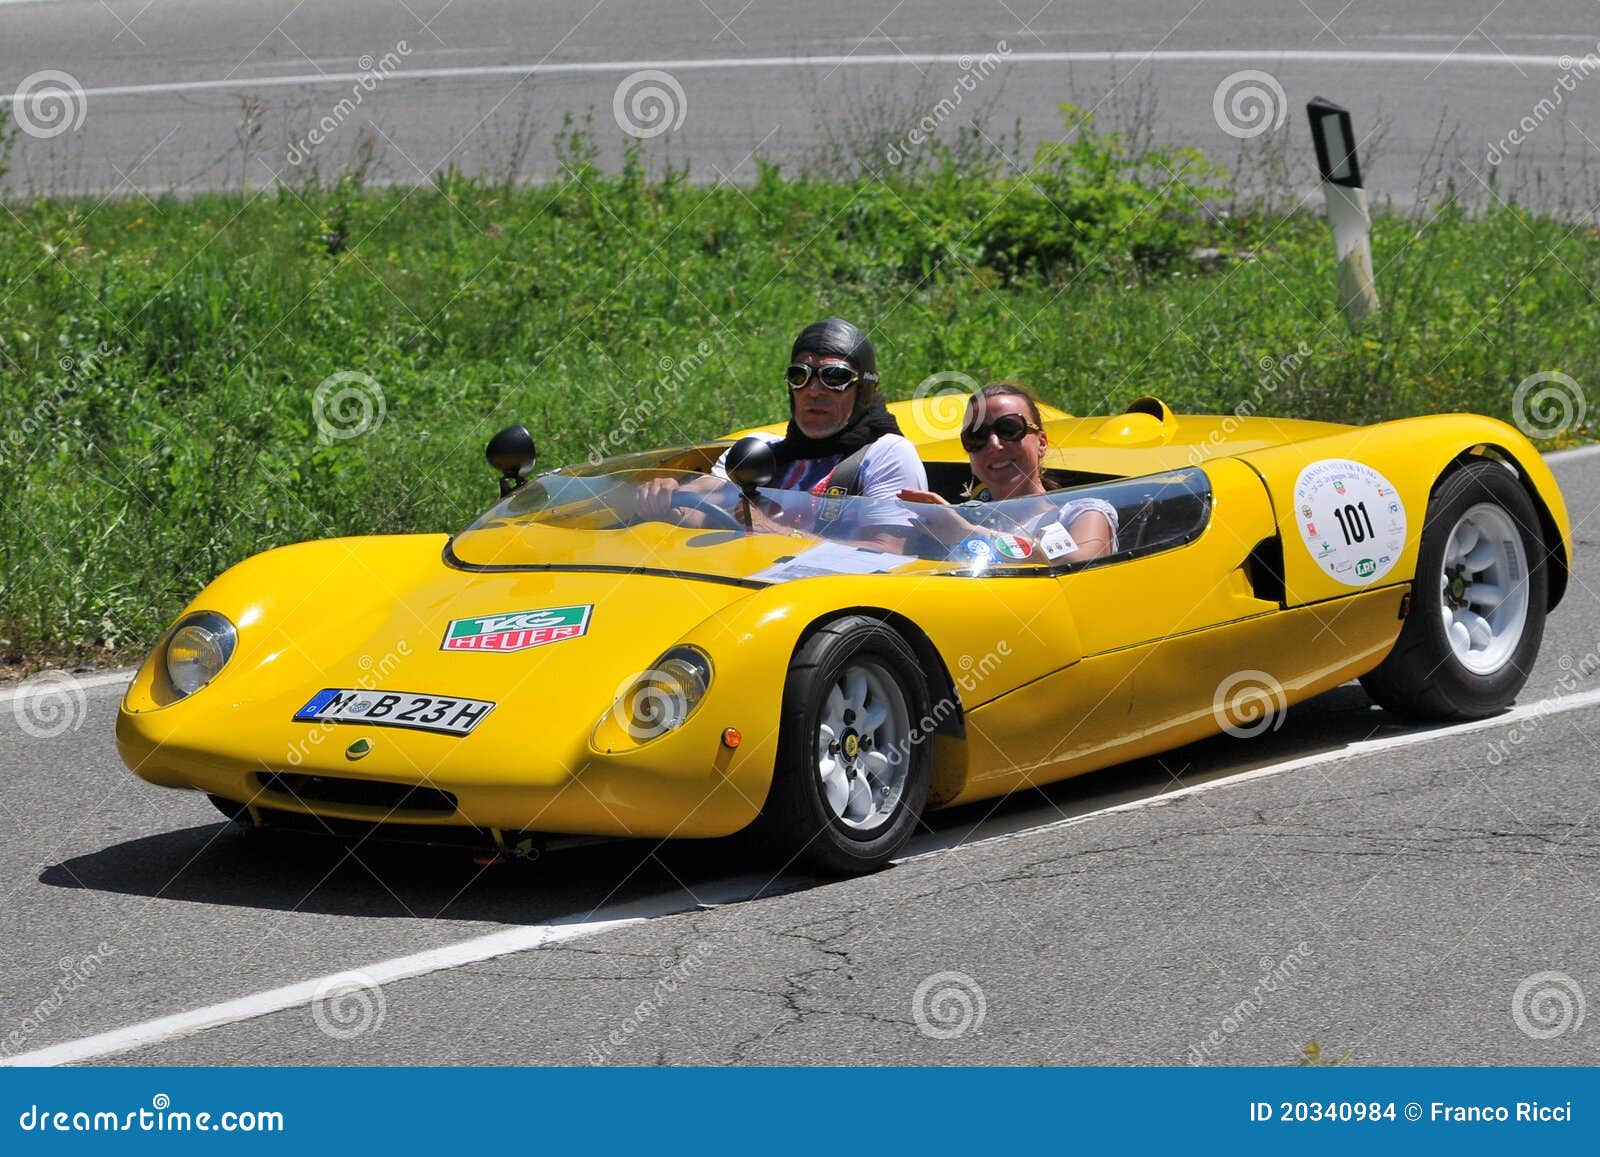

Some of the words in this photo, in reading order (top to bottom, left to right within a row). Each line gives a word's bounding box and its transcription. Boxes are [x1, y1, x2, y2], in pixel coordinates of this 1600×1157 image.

[1334, 501, 1375, 545] 101
[475, 610, 566, 633] TAG
[456, 626, 574, 649] HEUER
[307, 705, 317, 713] D
[319, 692, 358, 715] M
